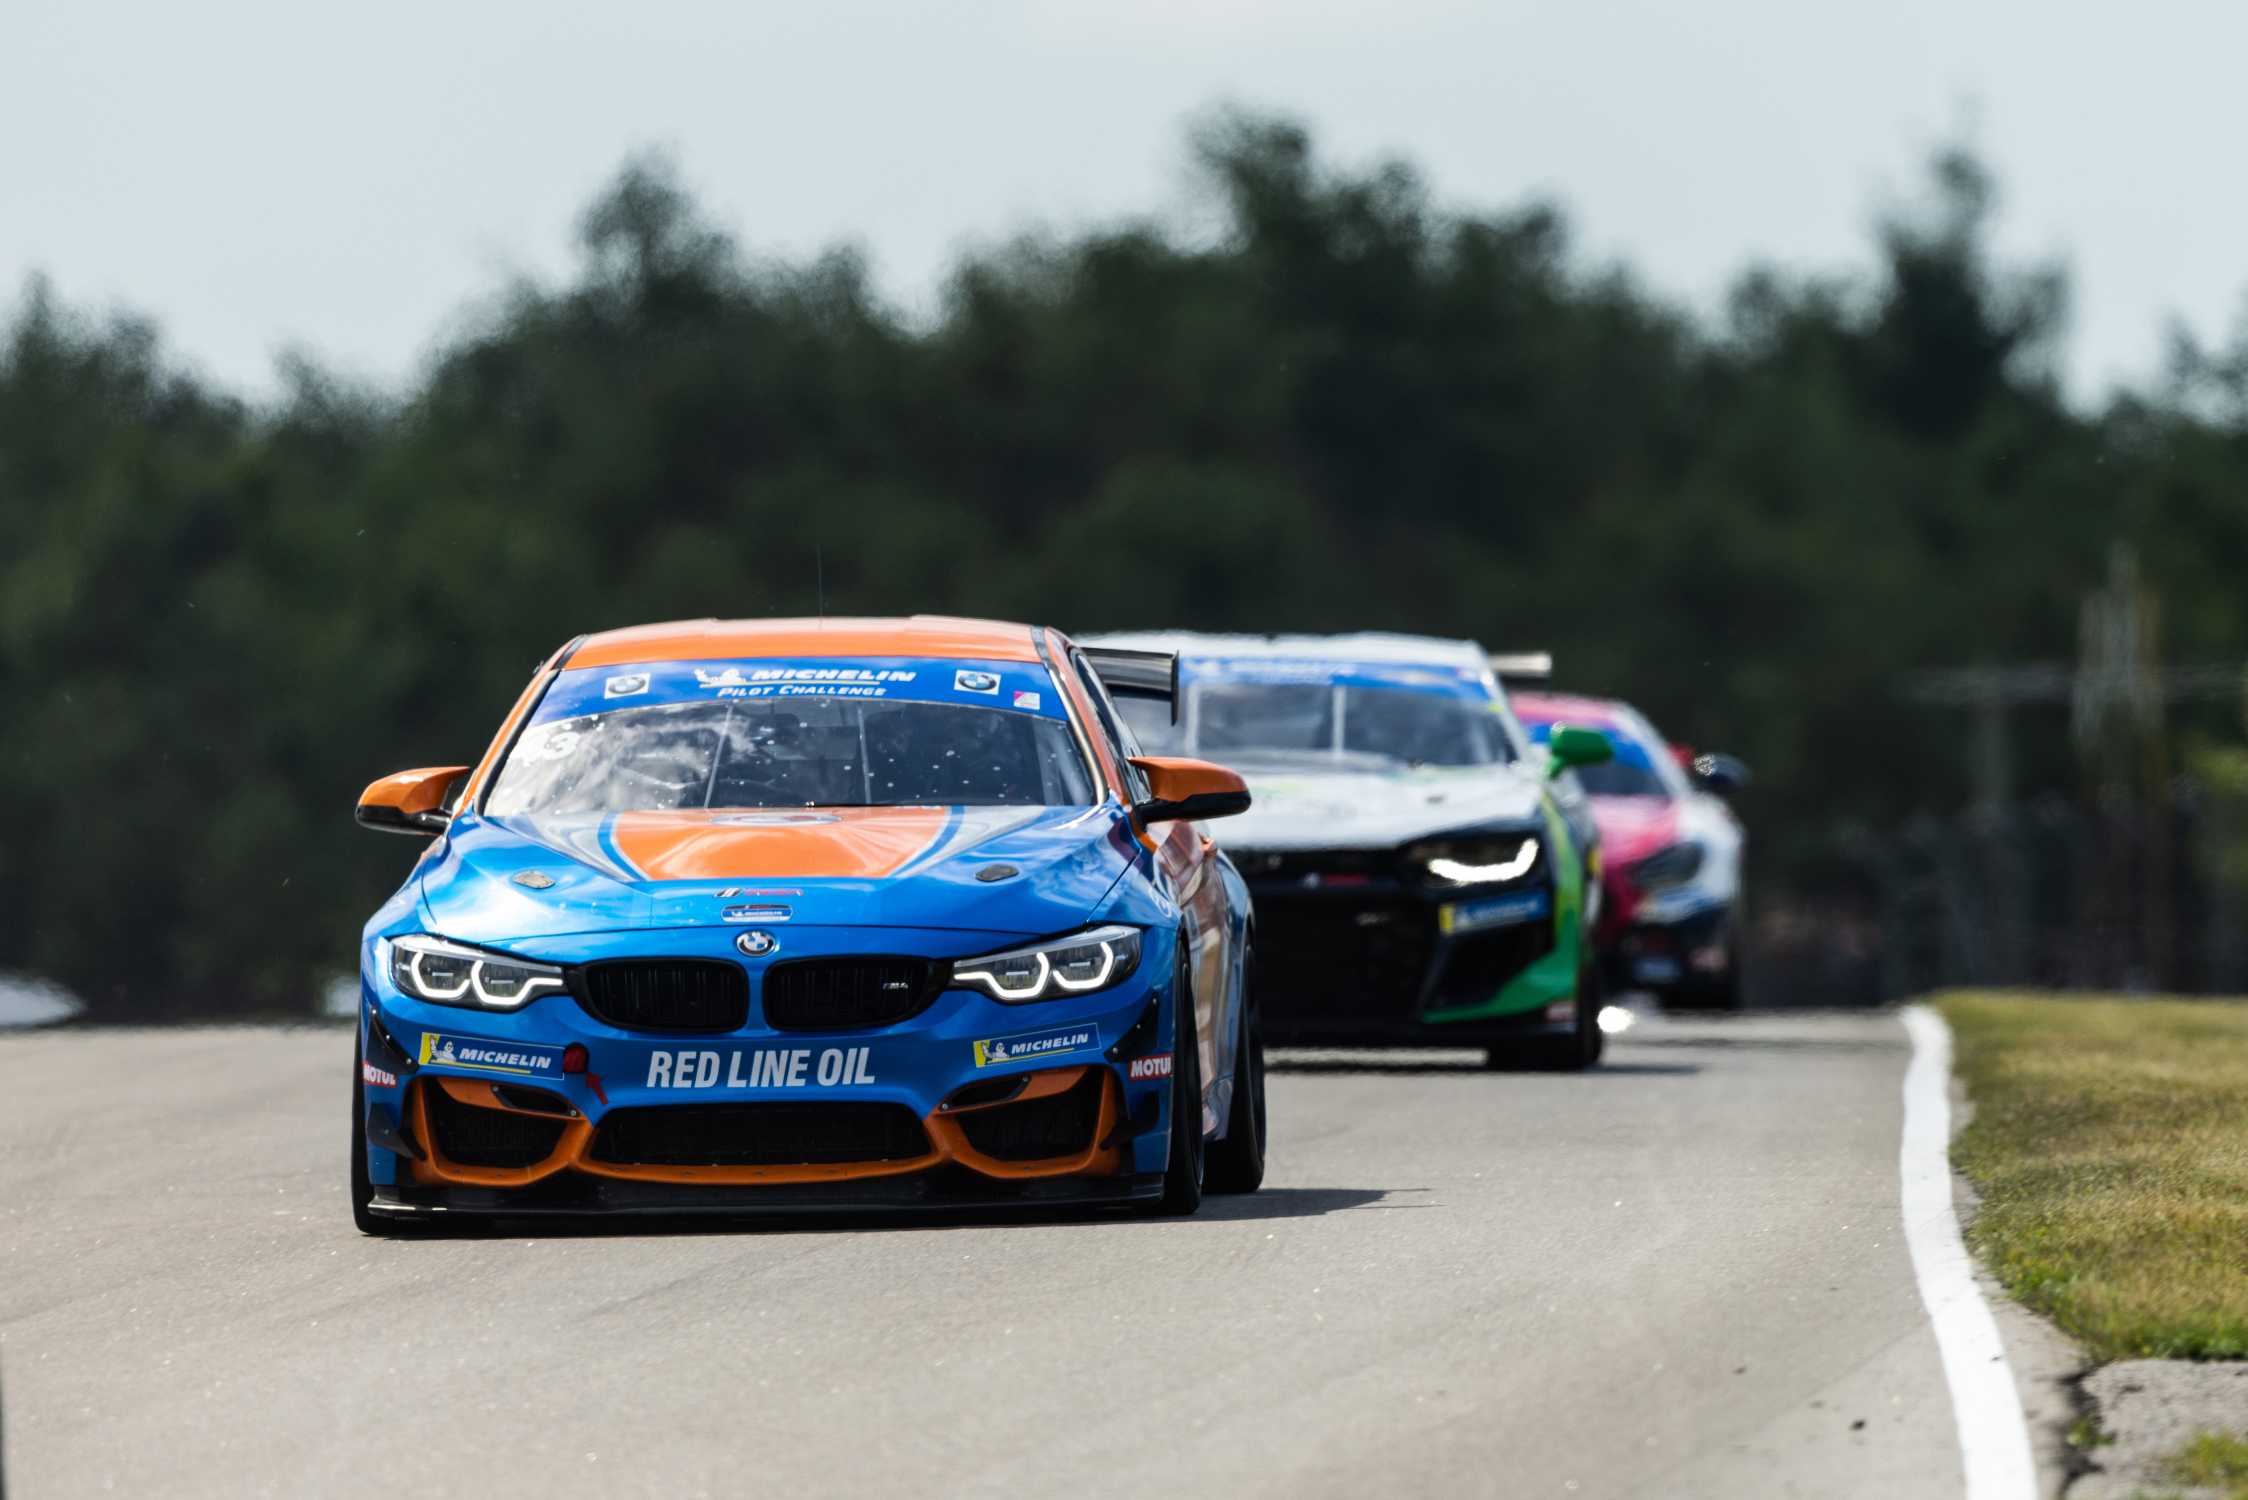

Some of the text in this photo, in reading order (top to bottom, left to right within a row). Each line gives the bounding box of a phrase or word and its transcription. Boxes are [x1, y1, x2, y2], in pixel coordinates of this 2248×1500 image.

[751, 669, 917, 682] MICHELIN
[717, 687, 774, 697] PILOT
[1011, 1033, 1089, 1054] MICHELIN
[459, 1047, 552, 1069] MICHELIN
[646, 1047, 876, 1089] RED LINE OIL
